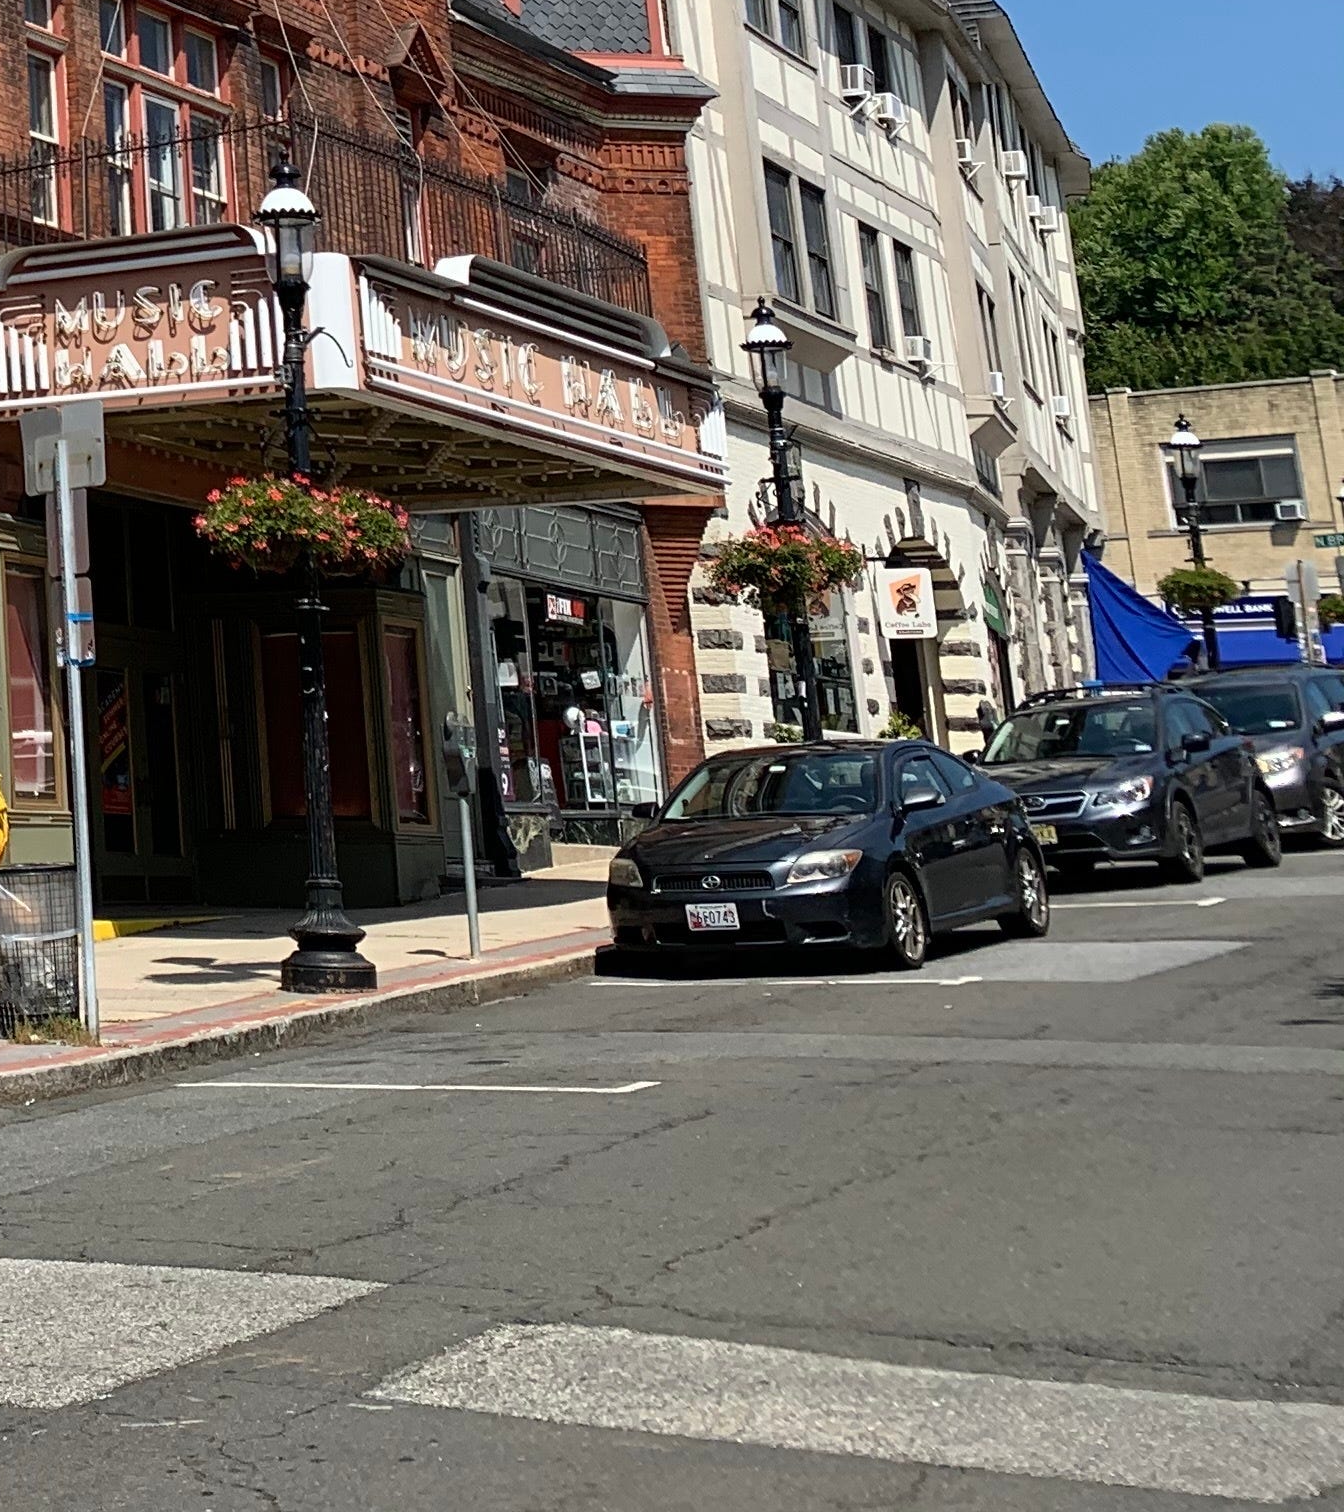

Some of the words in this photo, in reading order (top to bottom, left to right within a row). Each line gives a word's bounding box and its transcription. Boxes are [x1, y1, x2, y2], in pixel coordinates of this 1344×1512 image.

[54, 279, 224, 335] MUSIC
[54, 335, 231, 386] HALL
[408, 303, 545, 398] MUSIC
[560, 353, 686, 440] HALL
